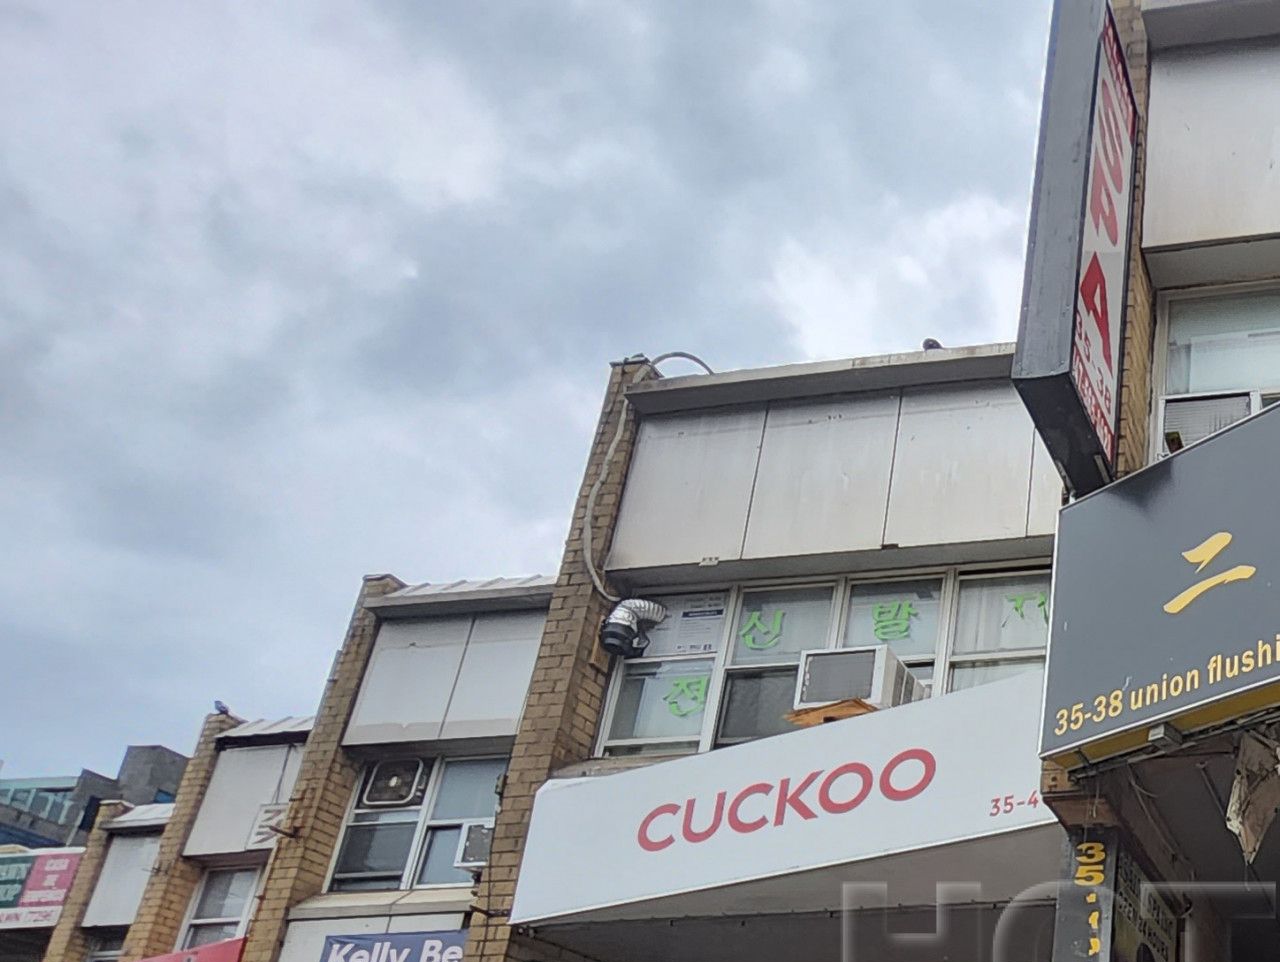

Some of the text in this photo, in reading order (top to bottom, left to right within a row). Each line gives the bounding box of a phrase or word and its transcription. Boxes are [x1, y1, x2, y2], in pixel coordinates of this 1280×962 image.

[1054, 689, 1123, 737] 35-38
[1129, 666, 1200, 711] union
[637, 748, 937, 850] CUCKOO
